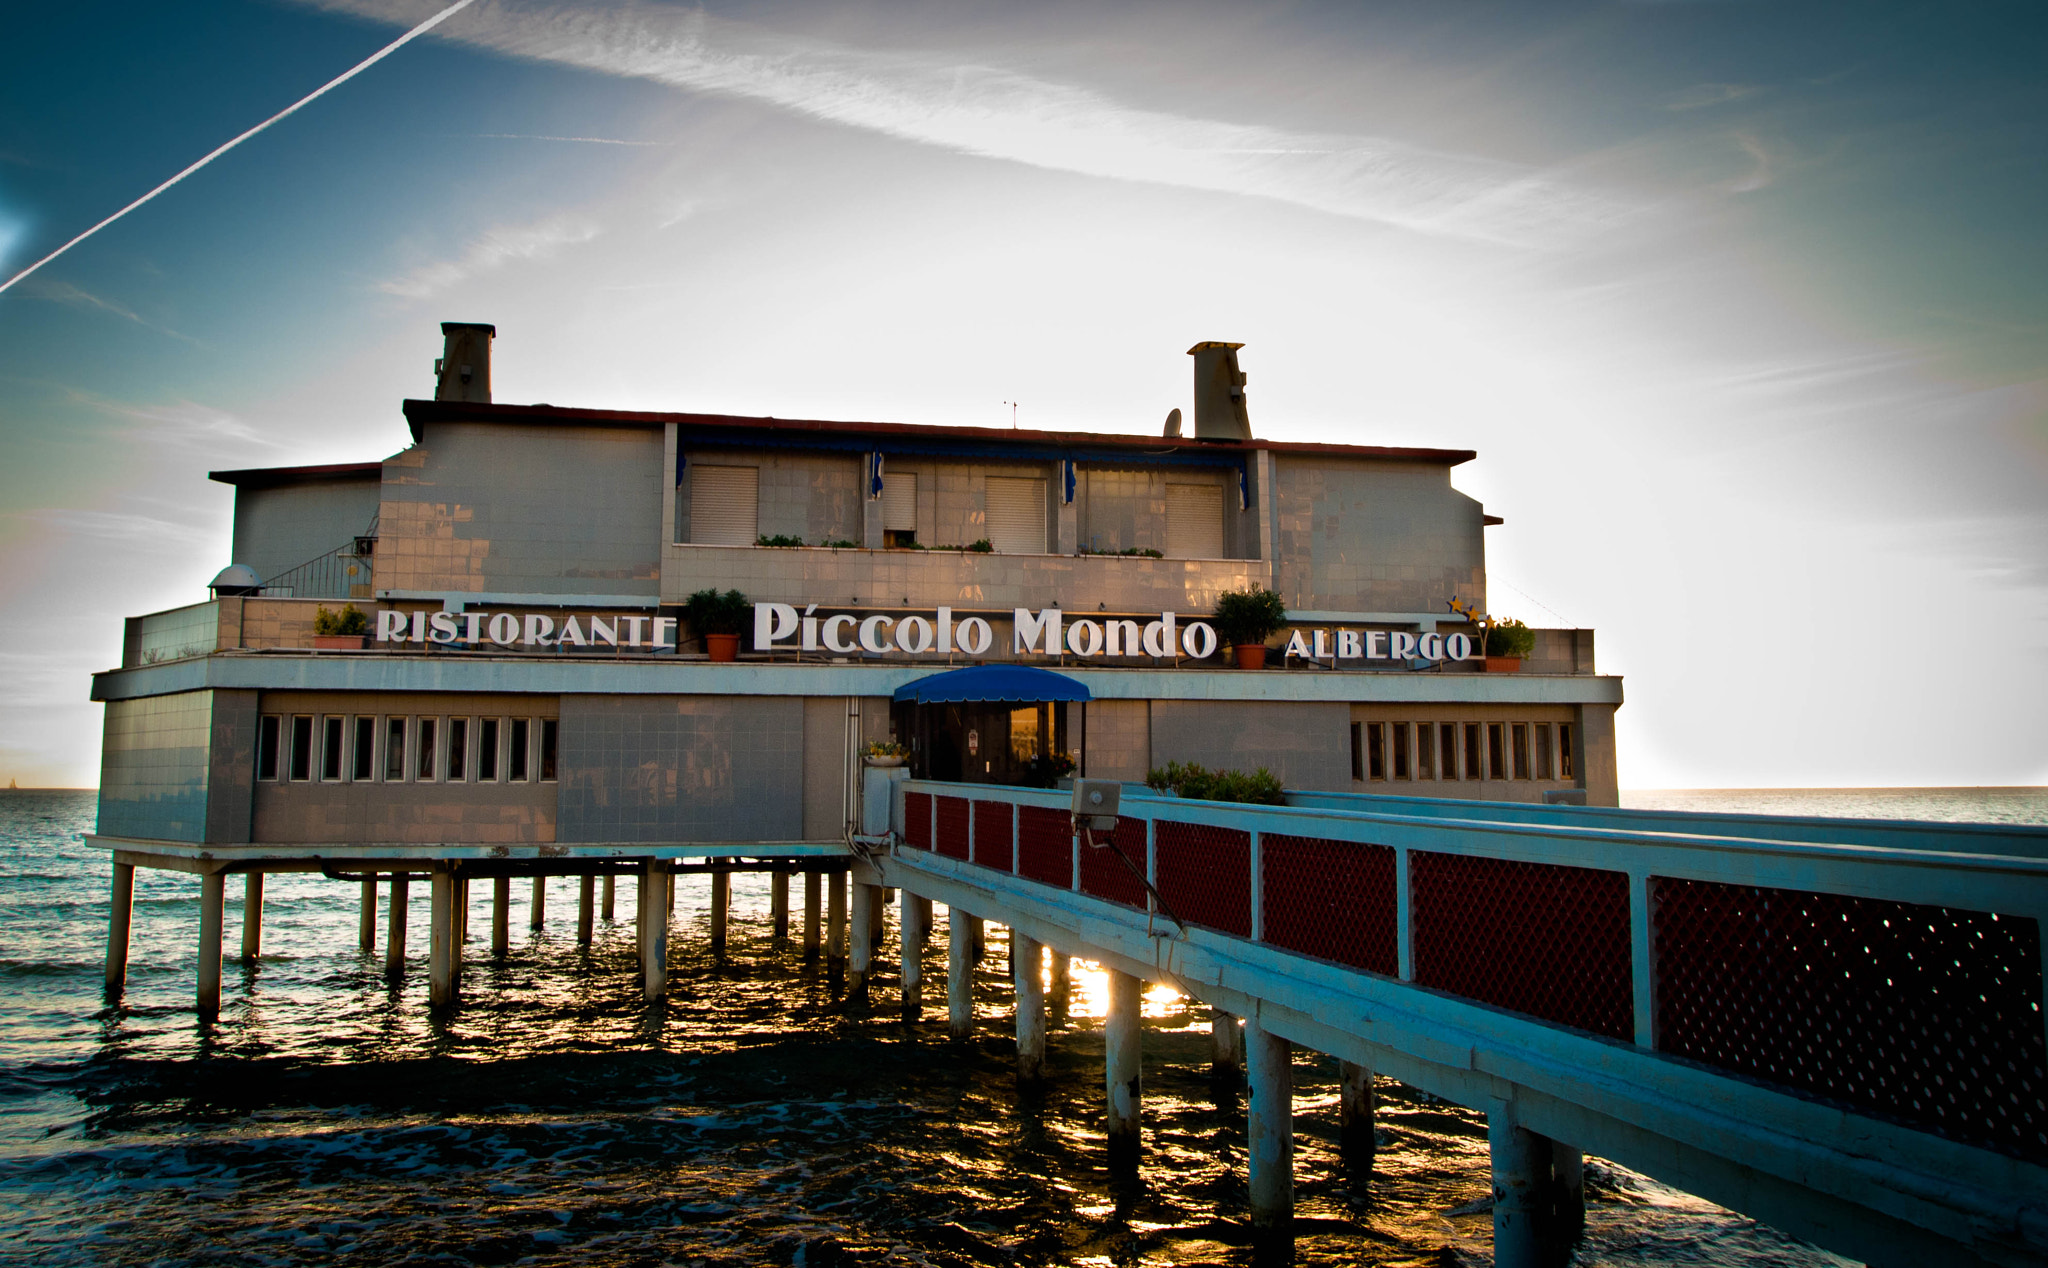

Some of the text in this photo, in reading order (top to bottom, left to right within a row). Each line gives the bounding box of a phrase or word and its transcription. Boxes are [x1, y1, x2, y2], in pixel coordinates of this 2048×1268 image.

[376, 610, 677, 648] RISTORANTE
[1013, 607, 1217, 659] Mondo
[1285, 629, 1471, 661] ALBERGO
